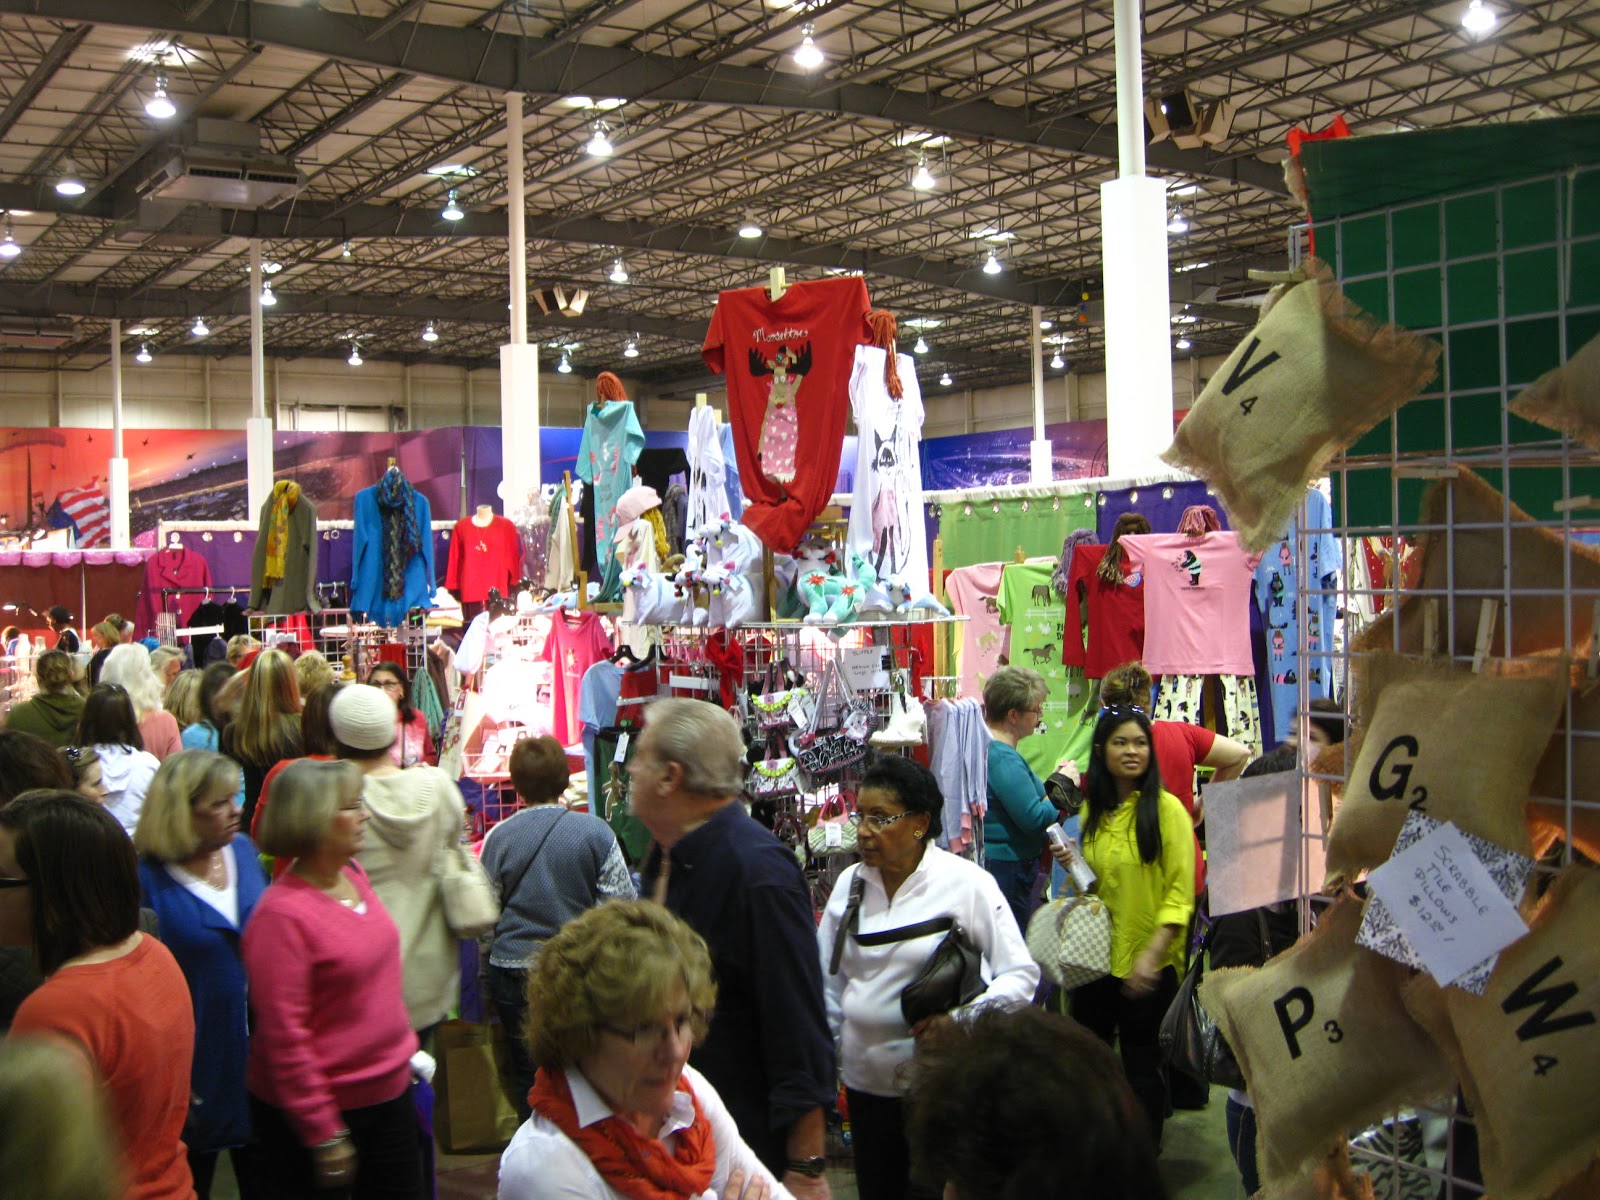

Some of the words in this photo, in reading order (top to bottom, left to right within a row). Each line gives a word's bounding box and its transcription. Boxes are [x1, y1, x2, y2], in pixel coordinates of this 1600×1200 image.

[1222, 336, 1281, 396] V
[1240, 396, 1258, 416] 4
[1369, 735, 1419, 801] G
[1409, 786, 1427, 812] 2
[1414, 867, 1458, 925] PILLOWS
[1427, 862, 1452, 893] TILE
[1434, 845, 1489, 916] SCRABBLE
[1273, 986, 1315, 1060] P
[1324, 1020, 1344, 1044] 3
[1501, 955, 1596, 1042] W
[1533, 1054, 1559, 1077] 4
